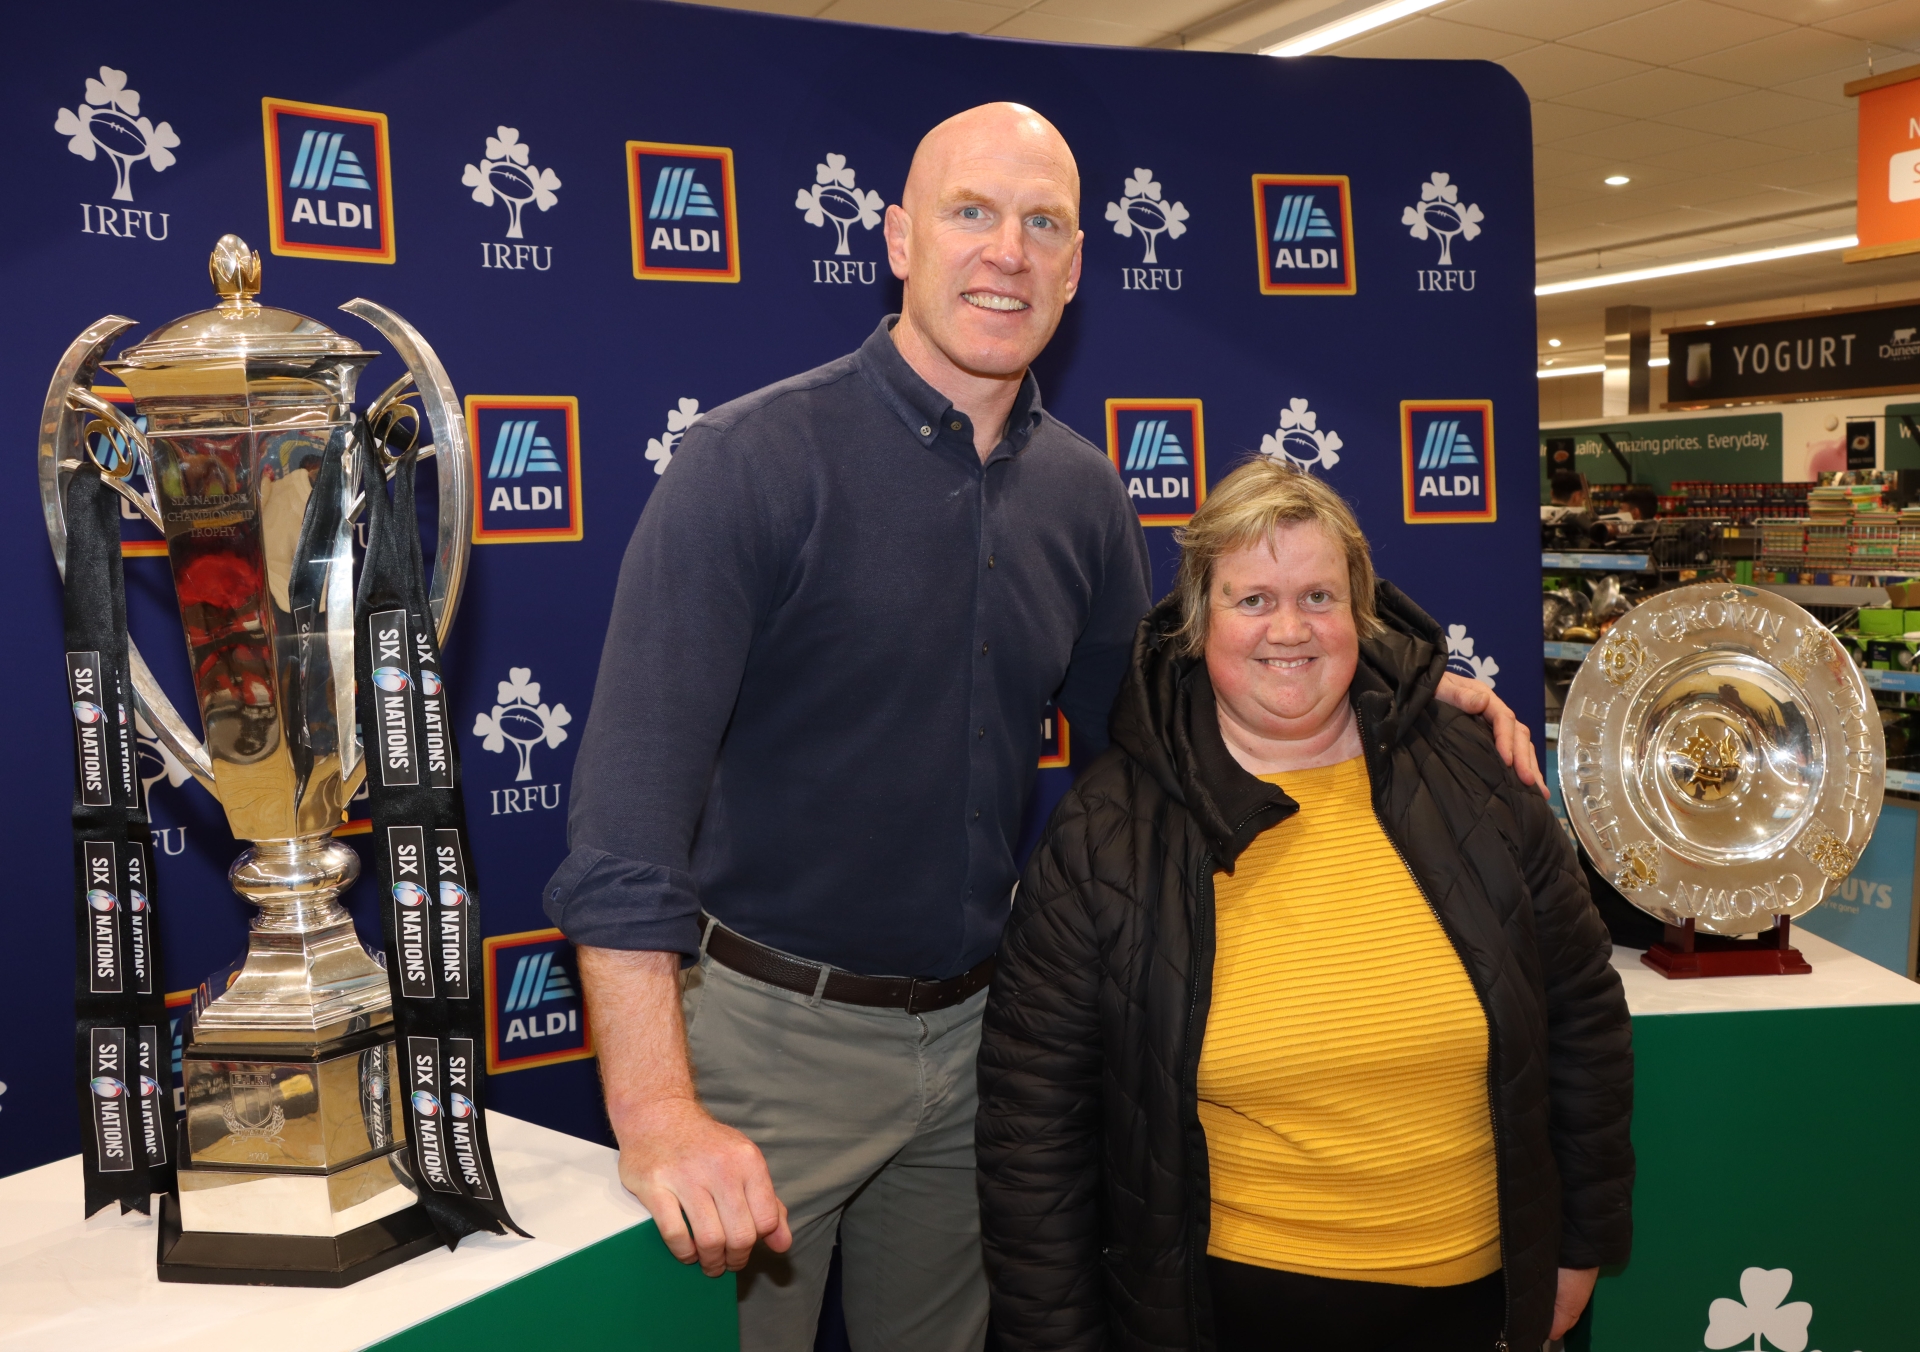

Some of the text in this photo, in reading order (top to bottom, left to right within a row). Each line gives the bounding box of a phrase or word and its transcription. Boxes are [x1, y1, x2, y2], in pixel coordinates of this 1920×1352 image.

[81, 203, 170, 241] IRFU
[291, 198, 373, 230] ALDI
[651, 227, 720, 252] ALDI
[481, 243, 553, 271] IRFU
[812, 260, 877, 285] IRFU
[1275, 248, 1338, 269] ALDI
[1122, 268, 1183, 291] IRFU
[1417, 270, 1476, 292] IRFU
[1733, 334, 1857, 375] YOGURT
[1575, 430, 1769, 458] uality. mazing prices. Everyday.
[171, 493, 249, 506] SIX NATIONS
[489, 486, 563, 511] ALDI
[1128, 477, 1189, 499] ALDI
[1419, 475, 1480, 497] ALDI
[166, 509, 254, 522] CHAMPIONSHIP
[188, 526, 236, 538] TROPHY
[1652, 600, 1786, 644] CROWN
[379, 628, 410, 769] SIX NATIONS
[416, 632, 446, 772] SIX NATIONS
[75, 668, 102, 792] SIX NATIONS
[490, 783, 562, 816] IRFU
[129, 857, 141, 885] SIX
[1669, 873, 1804, 920] CROWN
[1831, 877, 1892, 910] UYS
[92, 857, 115, 978] SIX NATIONS
[398, 844, 426, 982] SIX NATIONS
[436, 846, 461, 982] SIX NATIONS
[505, 1009, 577, 1043] ALDI
[98, 1043, 124, 1158] SIX NATIONS
[416, 1054, 447, 1187] SIX NATIONS
[449, 1056, 481, 1186] SIX NATIONS
